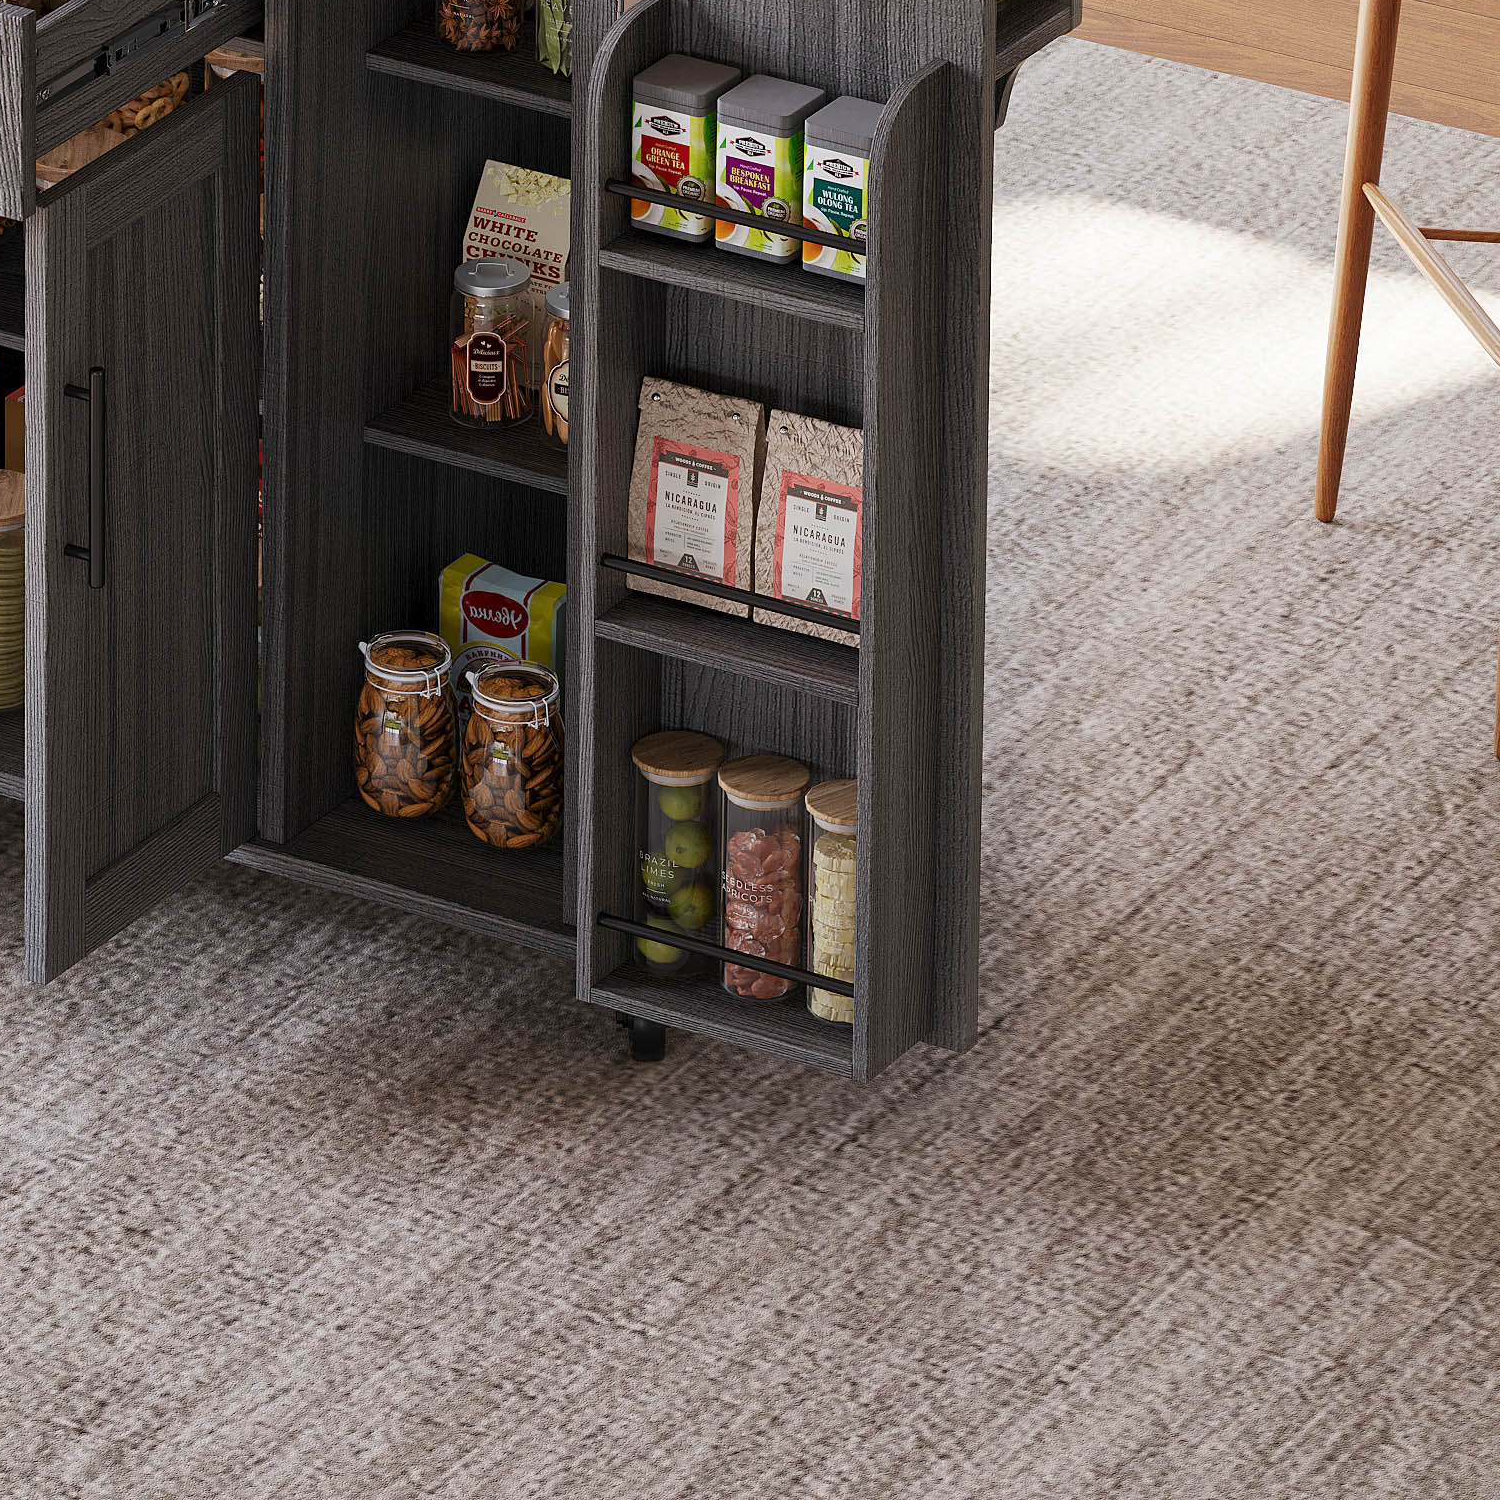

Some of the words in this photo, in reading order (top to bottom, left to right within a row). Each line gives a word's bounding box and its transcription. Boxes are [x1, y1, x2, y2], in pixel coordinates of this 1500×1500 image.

[651, 146, 680, 160] ORANGE
[646, 154, 670, 166] GREEN
[671, 159, 685, 170] TEA
[729, 174, 771, 192] BREAKFAST
[731, 166, 770, 183] BESPOKEN
[817, 196, 843, 210] OLONG
[845, 203, 859, 213] TEA
[822, 189, 854, 205] WULONG
[473, 215, 539, 243] WHITE
[468, 231, 563, 264] CHOCOLATE
[474, 361, 499, 371] BISCUITS
[665, 490, 717, 514] NICARAGUA
[793, 524, 846, 548] NICARAGUA
[684, 556, 693, 564] 12
[812, 590, 821, 599] 12
[639, 850, 679, 868] BRAZIL
